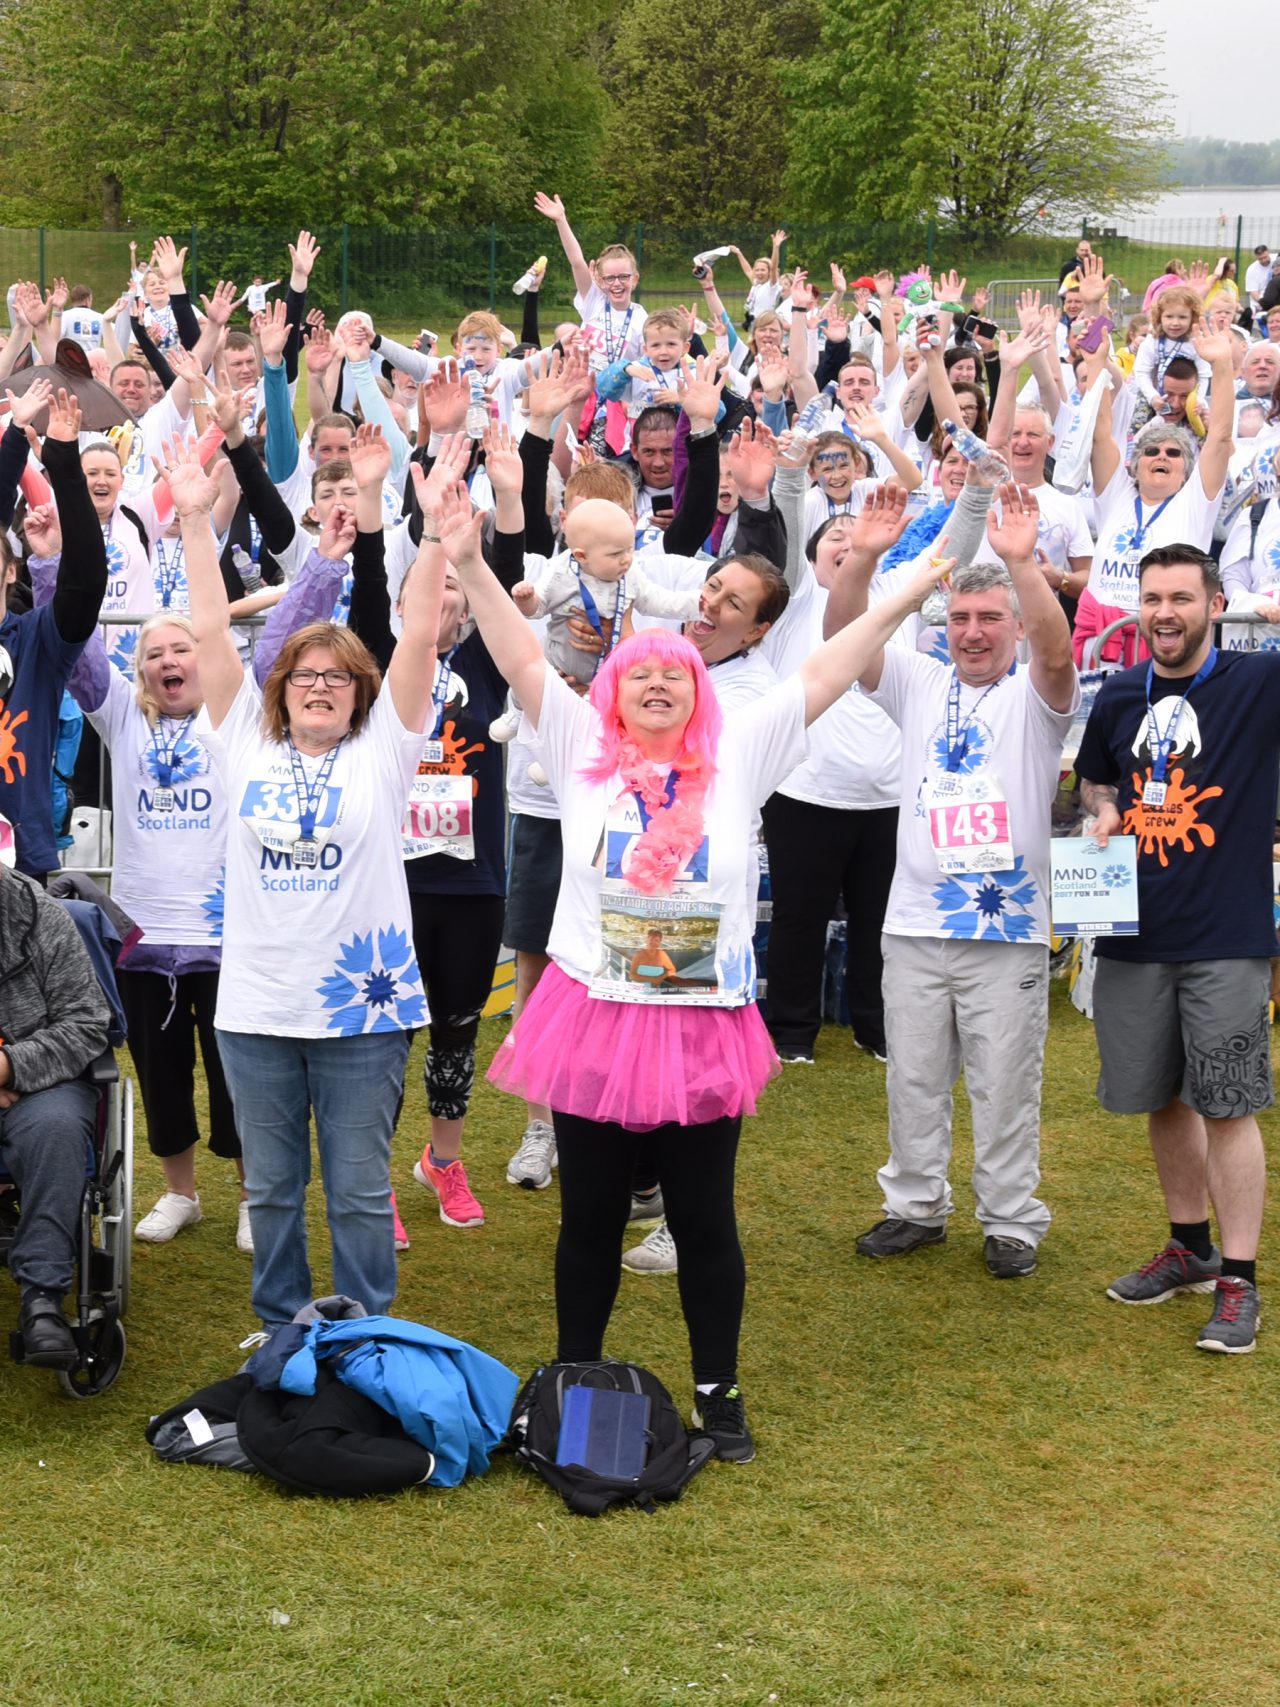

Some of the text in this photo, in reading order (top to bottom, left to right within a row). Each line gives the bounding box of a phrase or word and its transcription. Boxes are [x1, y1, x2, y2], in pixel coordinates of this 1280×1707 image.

[1258, 480, 1278, 494] MN
[107, 581, 127, 597] ND
[1099, 578, 1140, 591] Scotlan
[268, 764, 294, 776] MN
[137, 814, 211, 830] Scotland
[936, 803, 997, 847] 143
[263, 836, 284, 847] RUN
[1054, 868, 1097, 881] MND
[261, 874, 339, 891] Scotland
[1054, 881, 1097, 890] Scotland
[669, 902, 697, 912] AGNES
[1193, 1057, 1254, 1087] TAPOUT
